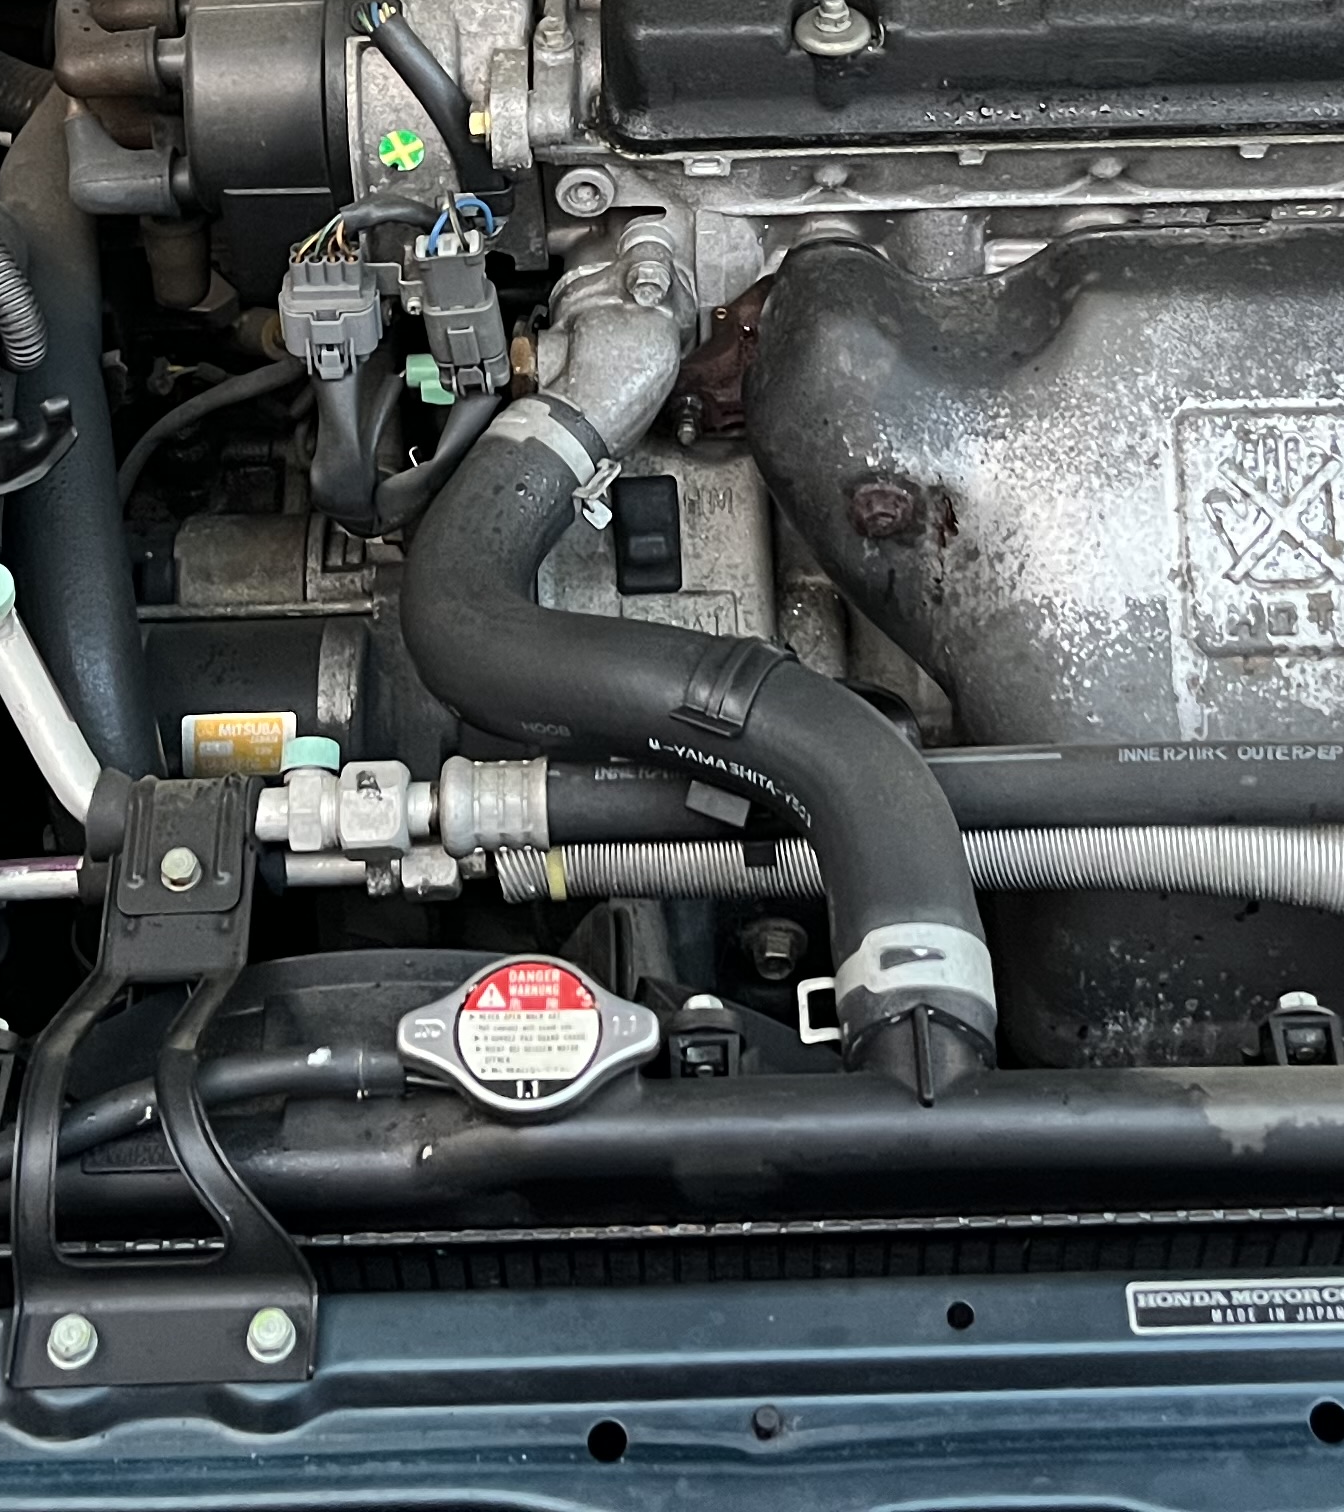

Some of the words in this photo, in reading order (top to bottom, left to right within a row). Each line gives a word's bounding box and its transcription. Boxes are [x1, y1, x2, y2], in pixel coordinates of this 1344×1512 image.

[1225, 590, 1333, 644] HOT
[218, 722, 282, 737] MITSUBA
[508, 968, 561, 983] DANGER
[611, 1014, 638, 1037] 1.1
[516, 1080, 539, 1098] 1.1
[1136, 1290, 1230, 1308] HONDA
[1231, 1288, 1321, 1306] MOTOR
[1211, 1307, 1256, 1323] MADE
[1268, 1307, 1286, 1322] IN
